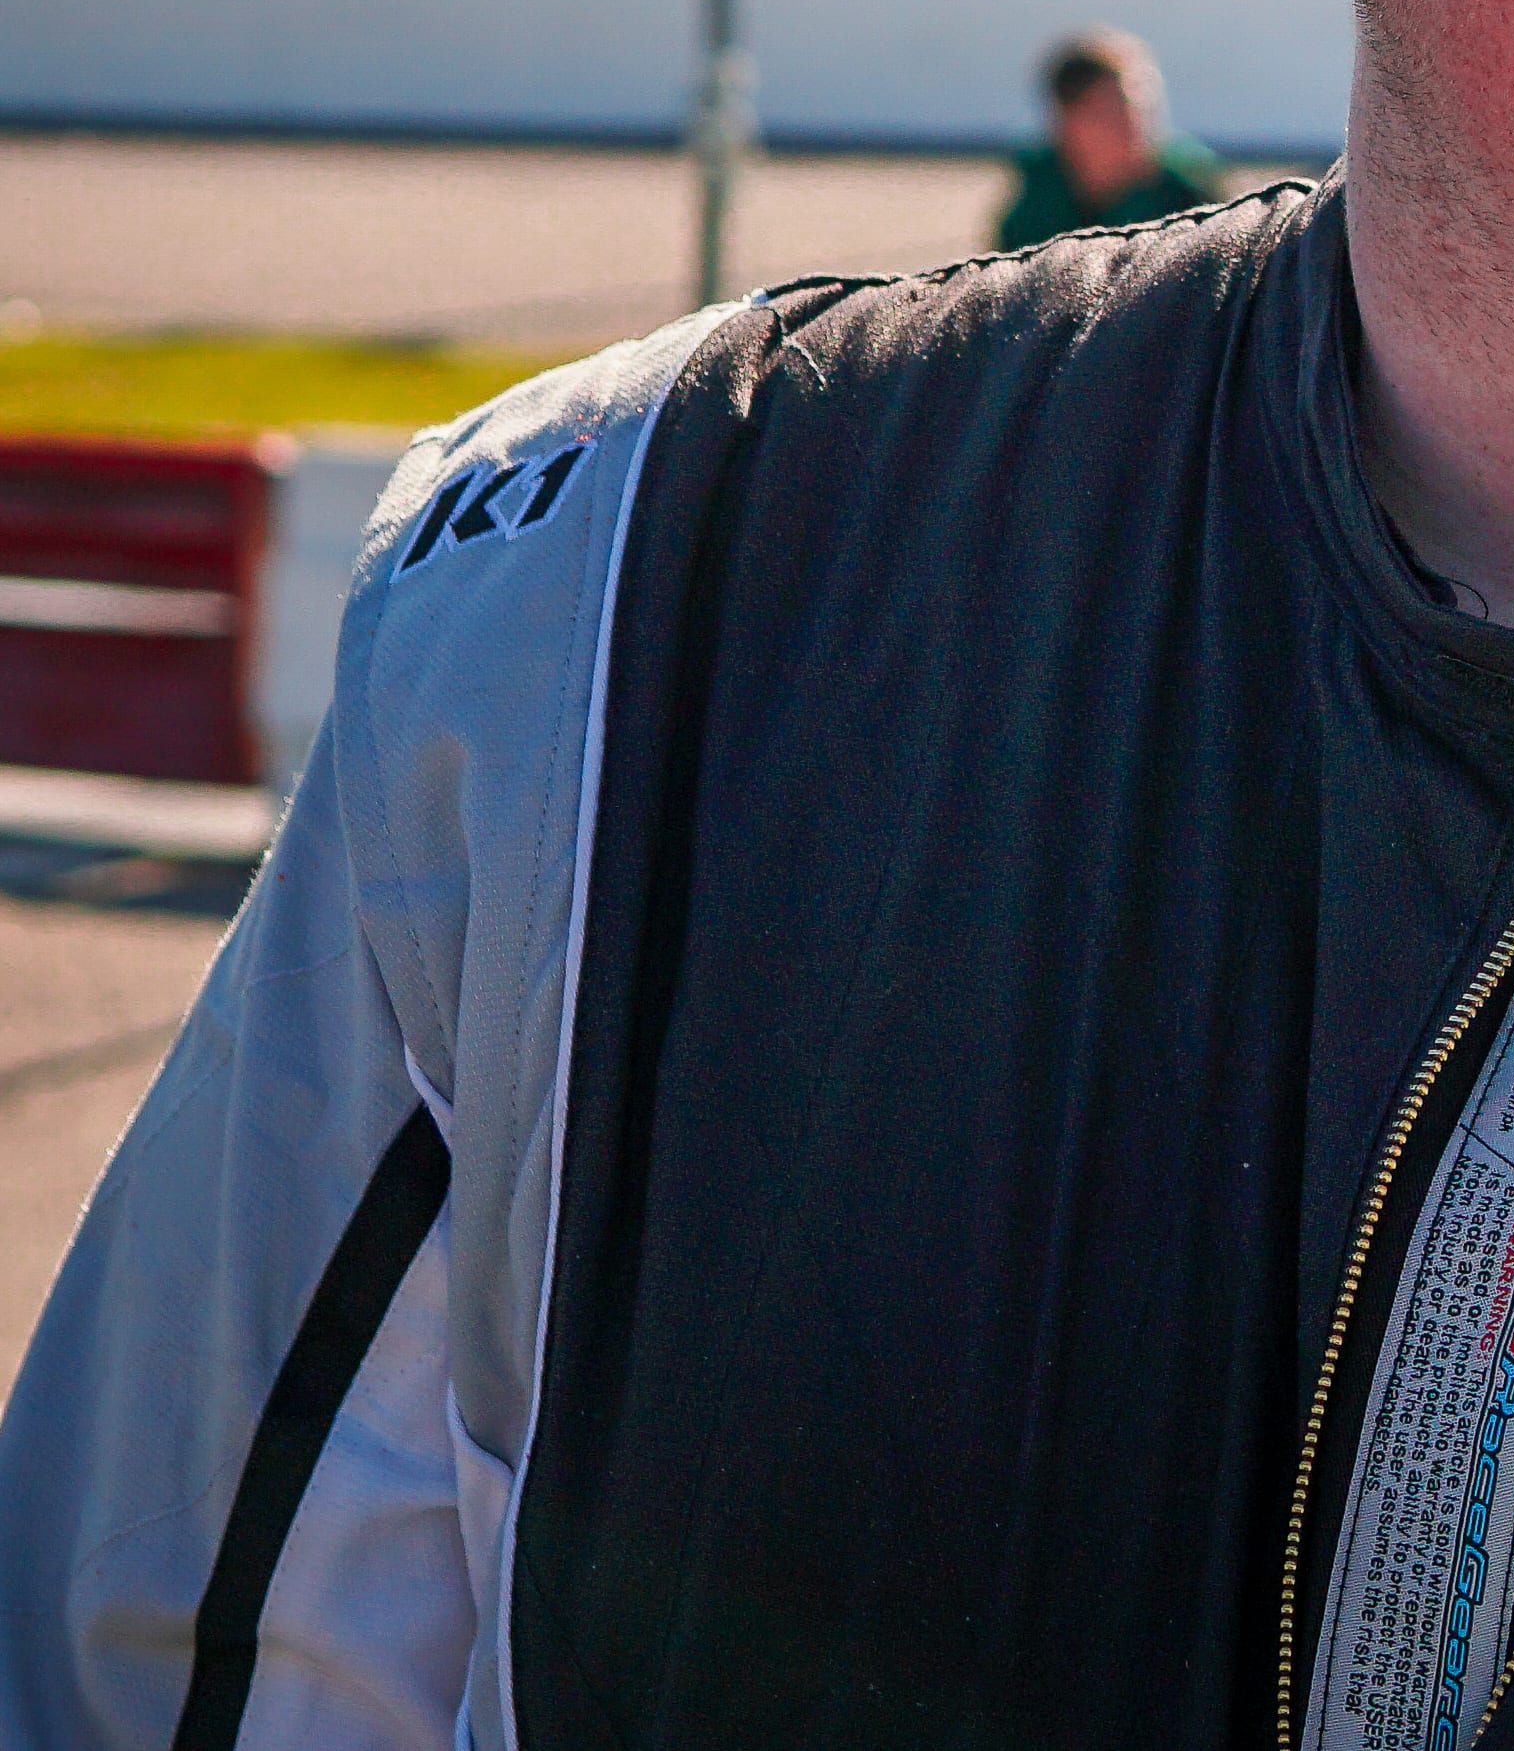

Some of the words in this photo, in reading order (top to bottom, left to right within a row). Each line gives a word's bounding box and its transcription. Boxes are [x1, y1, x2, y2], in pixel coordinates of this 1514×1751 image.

[392, 441, 597, 582] K1
[1459, 1163, 1489, 1207] from
[1485, 1172, 1506, 1189] is
[1461, 1196, 1493, 1254] made
[1414, 1216, 1444, 1290] sports
[1435, 1215, 1467, 1283] injury
[1454, 1261, 1472, 1288] as
[1402, 1298, 1422, 1334] can
[1429, 1289, 1444, 1314] or
[1447, 1295, 1465, 1316] to
[1467, 1307, 1482, 1328] or
[1393, 1344, 1413, 1368] be
[1436, 1325, 1459, 1359] the
[1399, 1386, 1424, 1424] The
[1462, 1368, 1487, 1412] This
[1363, 1377, 1404, 1495] dangerous.
[1411, 1366, 1445, 1462] products
[1389, 1432, 1408, 1482] user
[1446, 1417, 1470, 1489] article
[1396, 1470, 1420, 1537] ability
[1414, 1460, 1444, 1557] warranty
[1440, 1496, 1459, 1515] is
[1366, 1488, 1396, 1581] assumes
[1393, 1544, 1410, 1563] to
[1431, 1523, 1451, 1567] sold
[1410, 1563, 1425, 1584] or
[1360, 1588, 1382, 1623] the
[1378, 1571, 1402, 1647] protect
[1419, 1574, 1442, 1653] without
[1353, 1628, 1372, 1665] risk
[1371, 1654, 1392, 1686] the
[1344, 1673, 1367, 1715] that
[1402, 1661, 1429, 1750] warranty
[1362, 1694, 1385, 1748] USER
